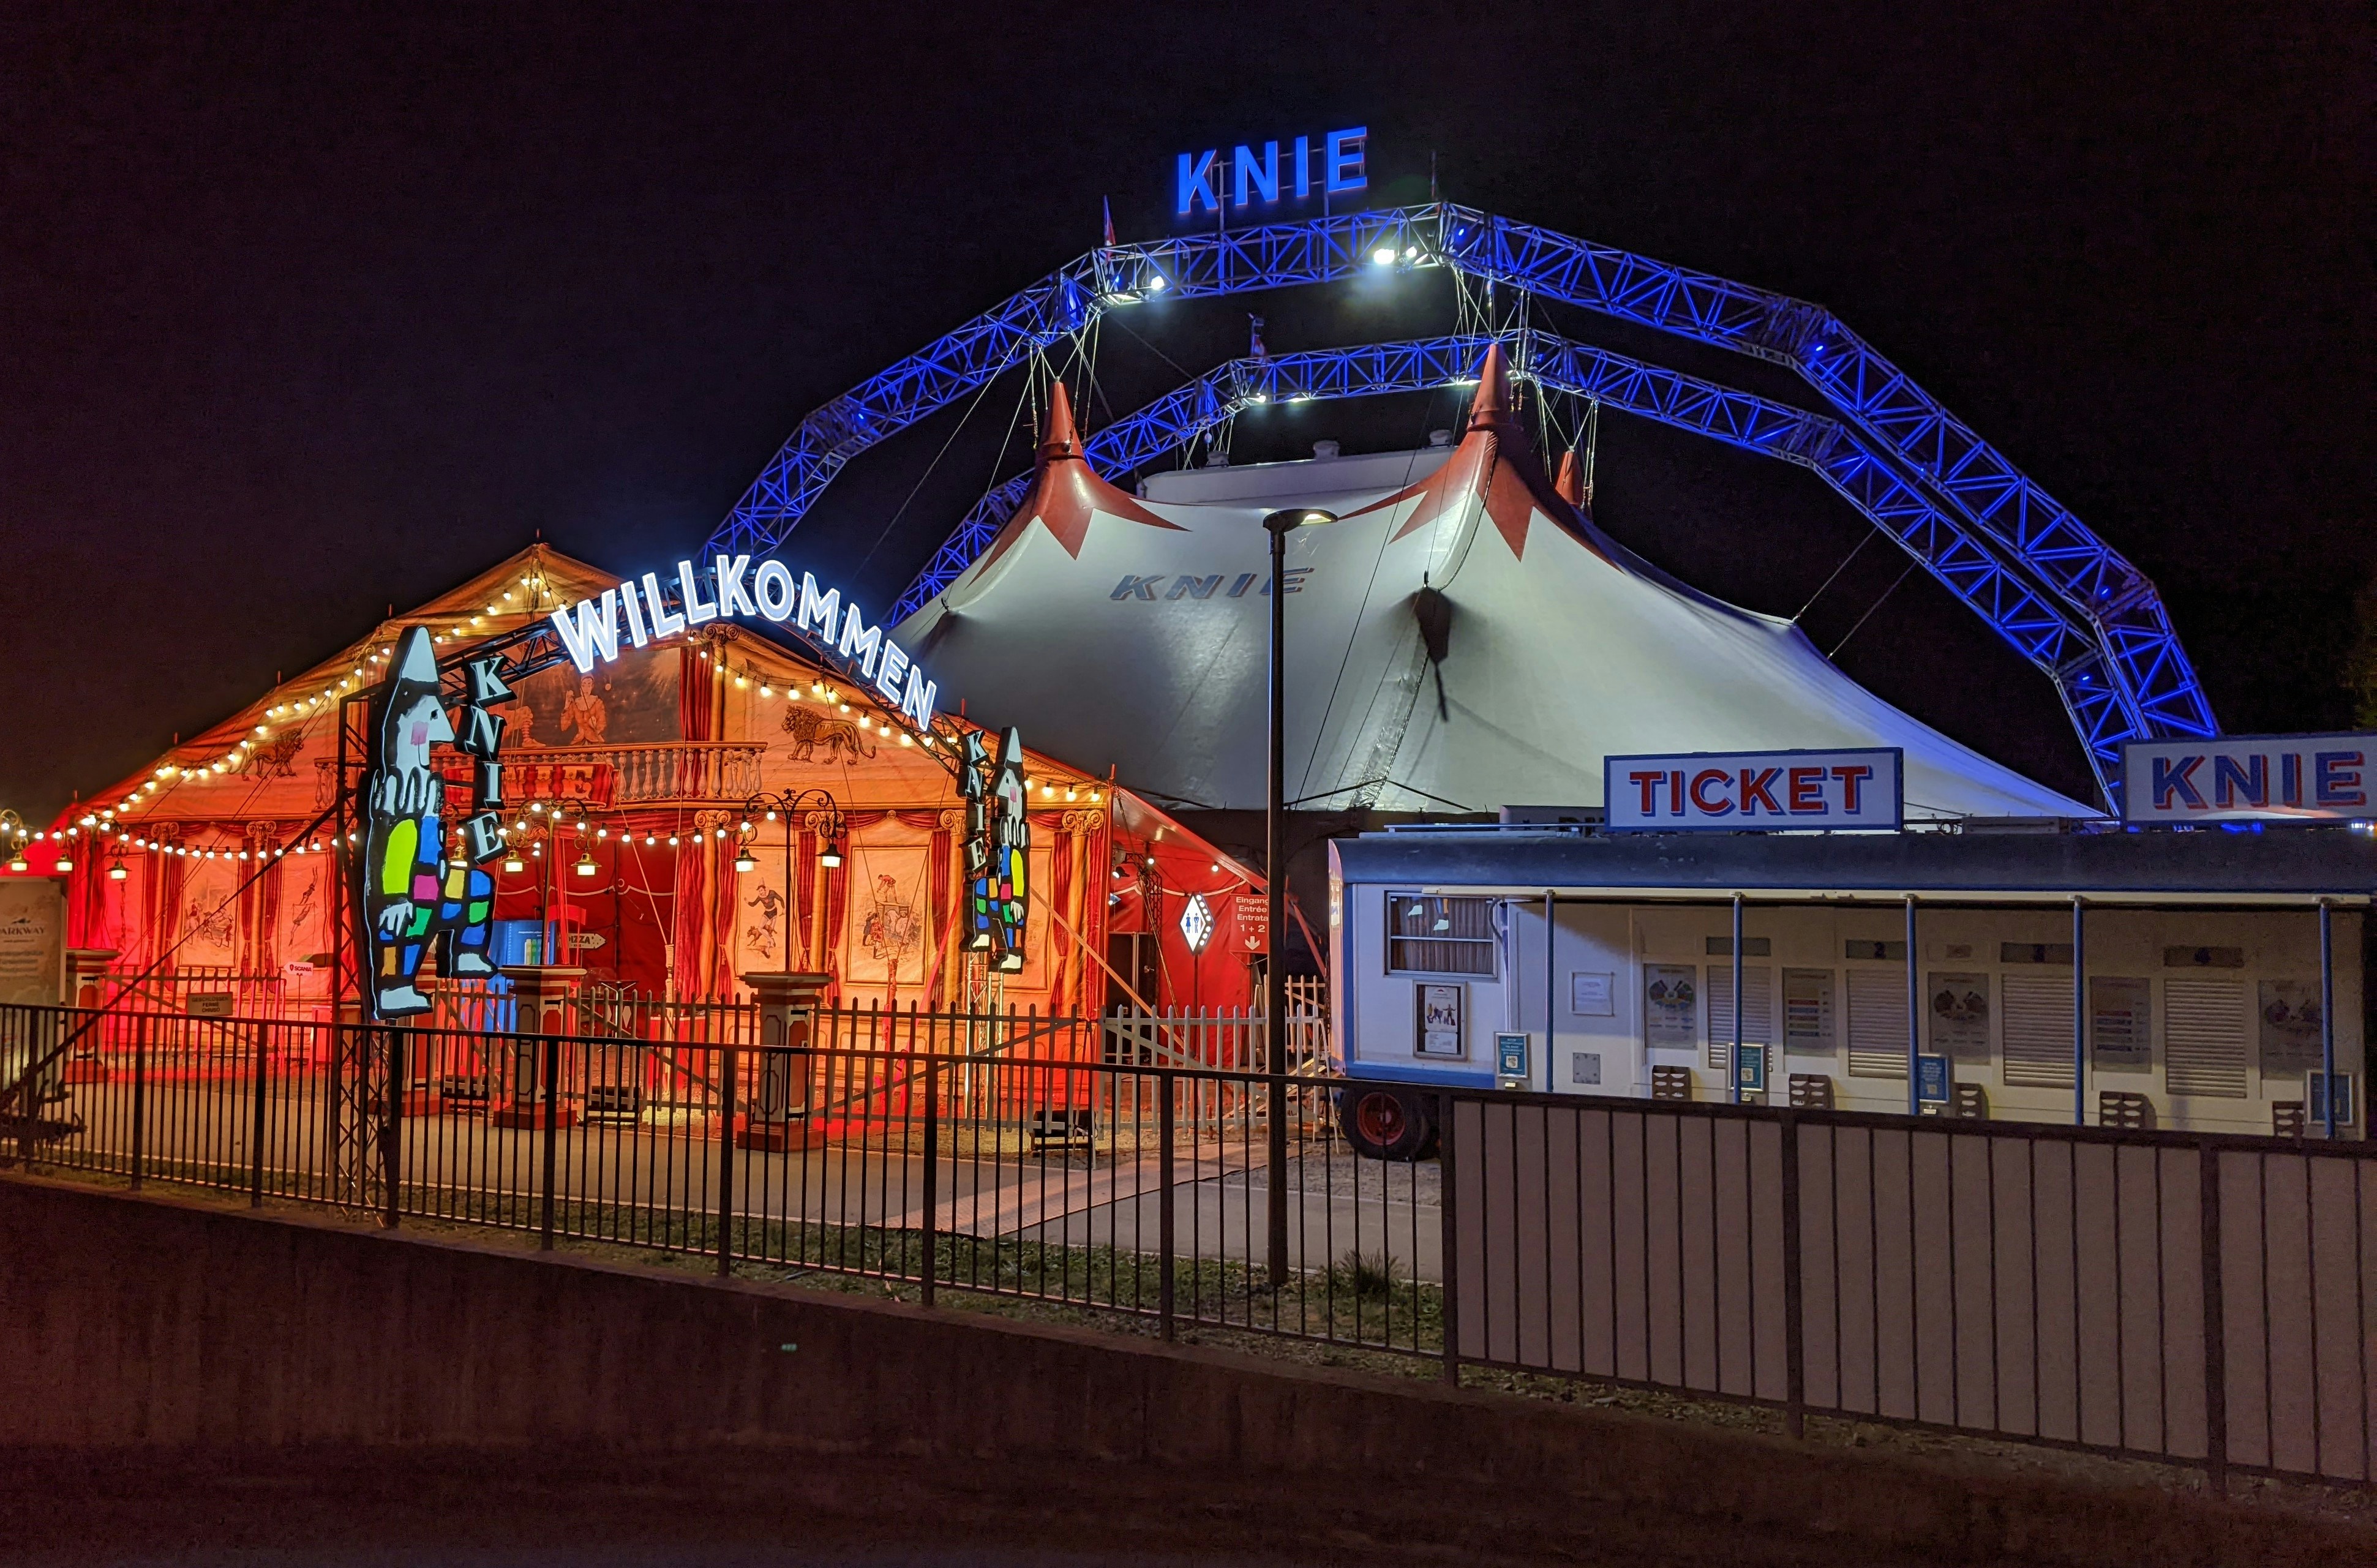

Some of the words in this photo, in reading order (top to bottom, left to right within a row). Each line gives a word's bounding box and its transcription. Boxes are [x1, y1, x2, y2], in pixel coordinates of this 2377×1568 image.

[1178, 126, 1367, 214] KNIE
[1109, 567, 1315, 601] KNIE
[550, 554, 937, 732] WILLKOMMEN
[466, 656, 513, 860] KNIE
[2152, 751, 2367, 809] KNIE
[965, 730, 988, 871] KNIE
[1629, 765, 1874, 817] TICKET
[0, 926, 44, 935] ARKWAY
[568, 935, 591, 944] IZZA
[1240, 923, 1245, 932] 1
